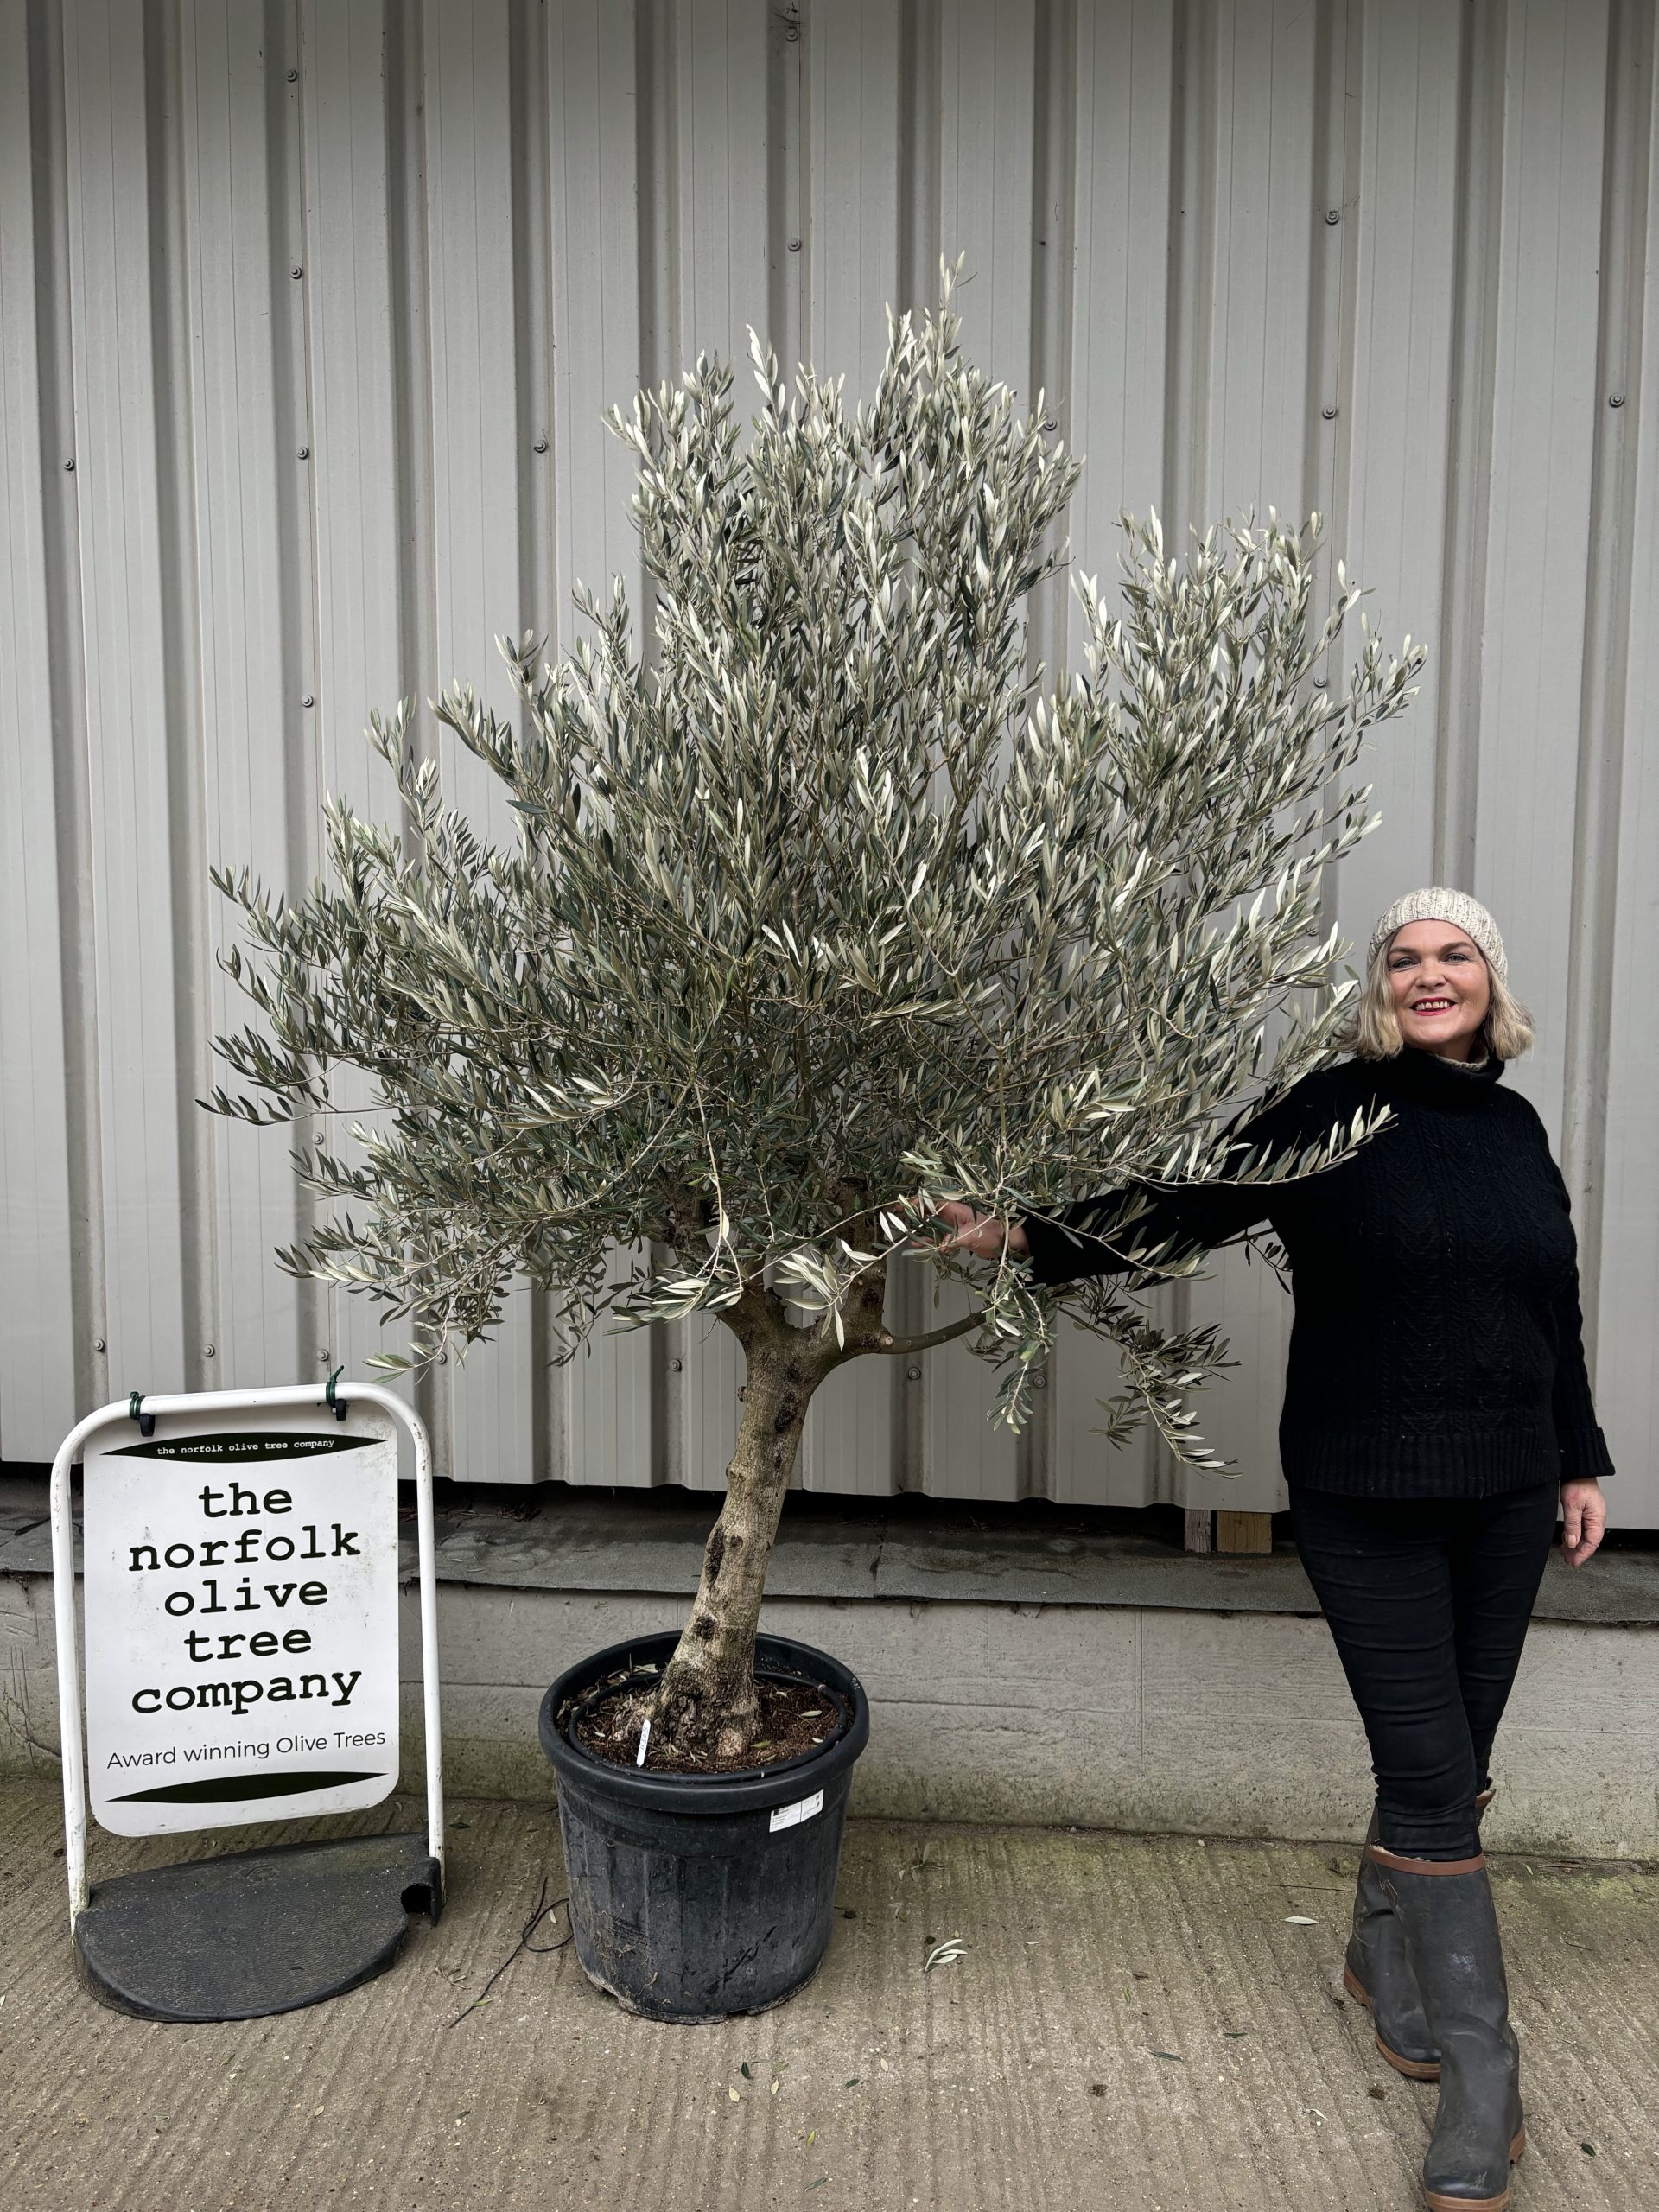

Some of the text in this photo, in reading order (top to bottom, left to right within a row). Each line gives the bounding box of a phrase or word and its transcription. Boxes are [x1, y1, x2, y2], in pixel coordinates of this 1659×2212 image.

[156, 1446, 175, 1455] the
[181, 1444, 224, 1453] norfolk
[228, 1443, 259, 1452] olive
[293, 1440, 334, 1449] company
[198, 1482, 292, 1518] the
[128, 1523, 361, 1572] norfolk
[164, 1576, 327, 1617] olive
[183, 1629, 312, 1662] tree
[131, 1670, 362, 1716] company
[106, 1732, 385, 1770] Award winning Olive Trees
